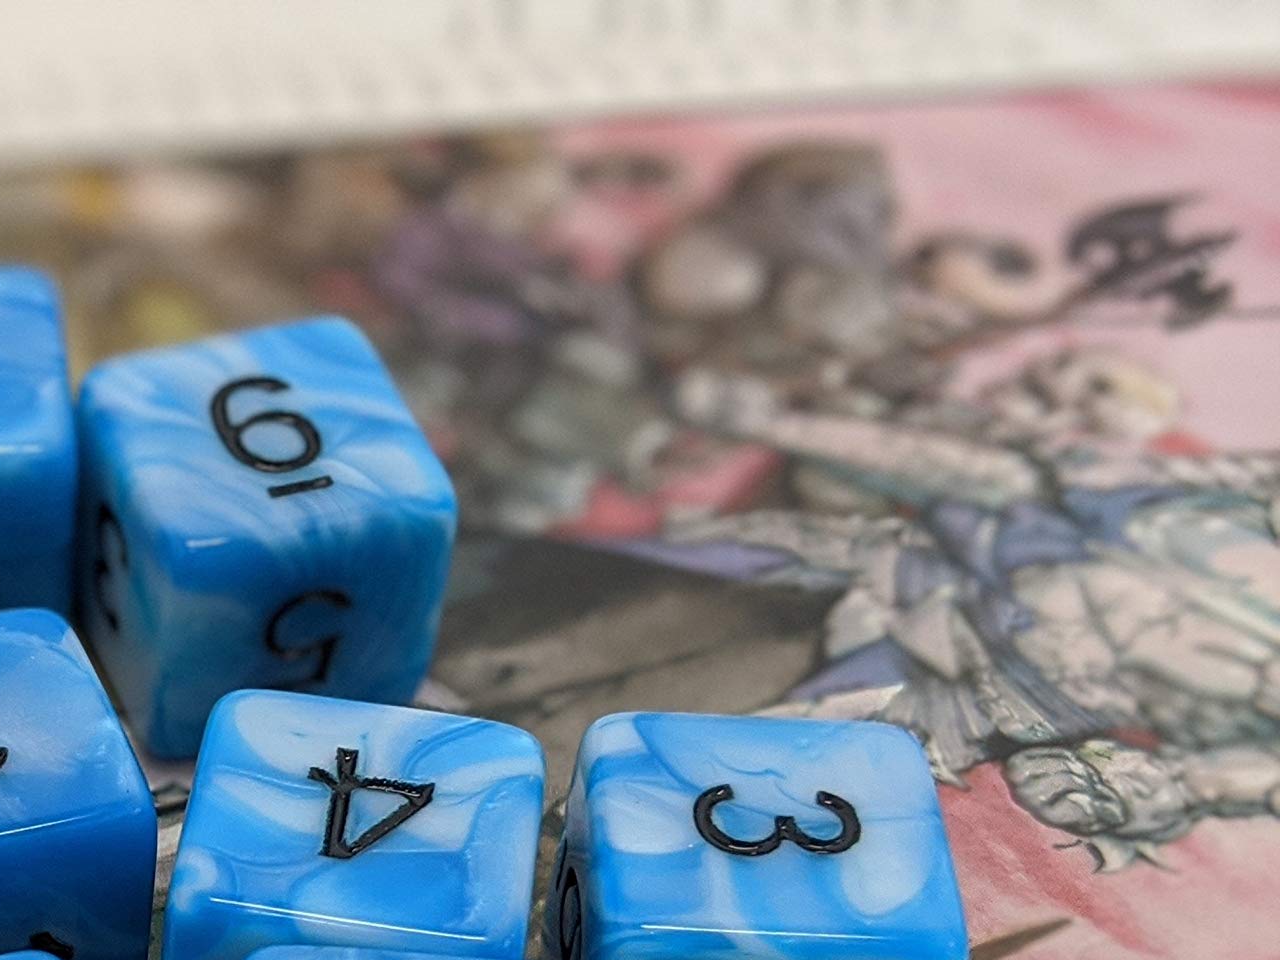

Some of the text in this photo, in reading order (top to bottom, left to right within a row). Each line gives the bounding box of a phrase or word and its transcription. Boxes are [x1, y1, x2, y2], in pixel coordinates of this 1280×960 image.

[265, 591, 351, 690] 5
[308, 747, 435, 860] 4
[693, 783, 861, 857] 3
